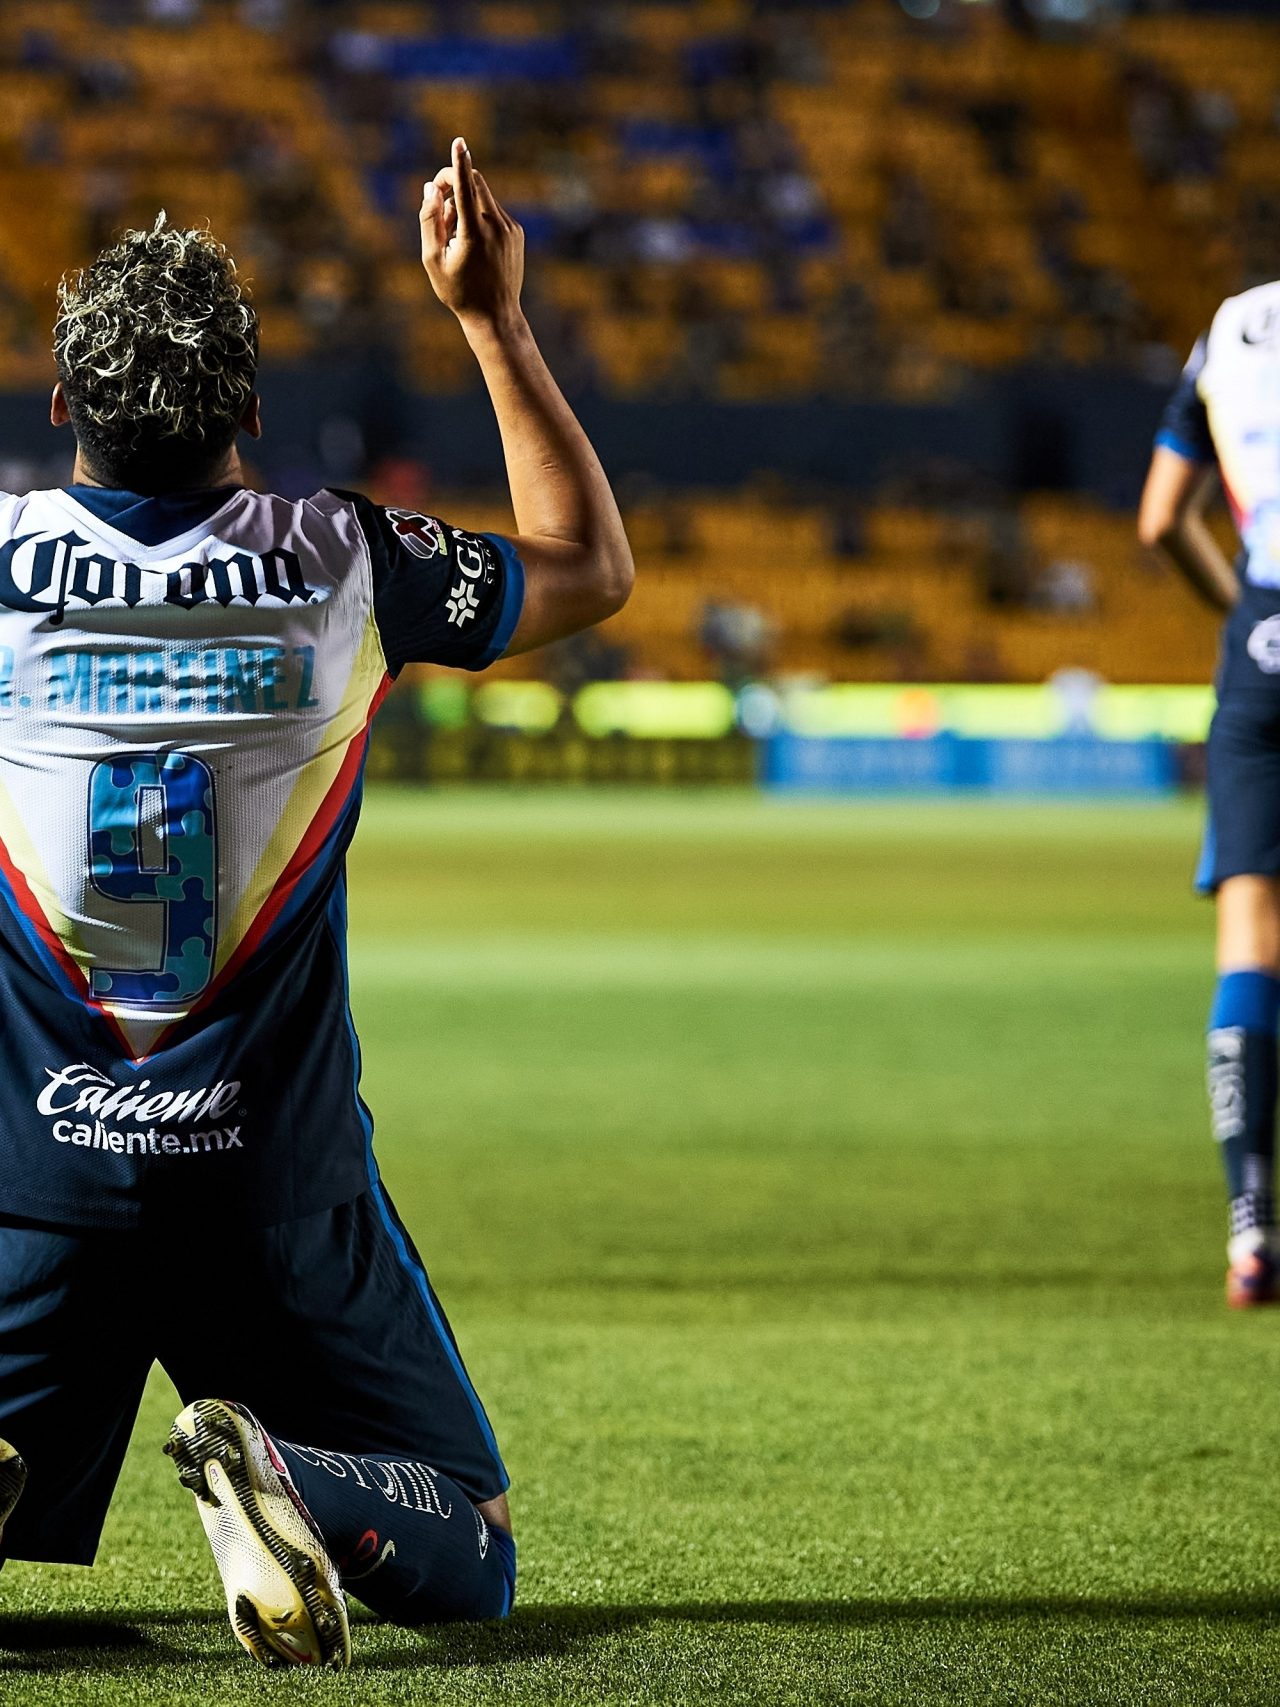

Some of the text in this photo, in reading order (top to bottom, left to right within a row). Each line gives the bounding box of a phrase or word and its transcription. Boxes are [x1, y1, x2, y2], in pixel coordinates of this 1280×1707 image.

[87, 750, 218, 1005] 9
[36, 1061, 242, 1123] Caliente
[52, 1119, 245, 1155] caliente.mx
